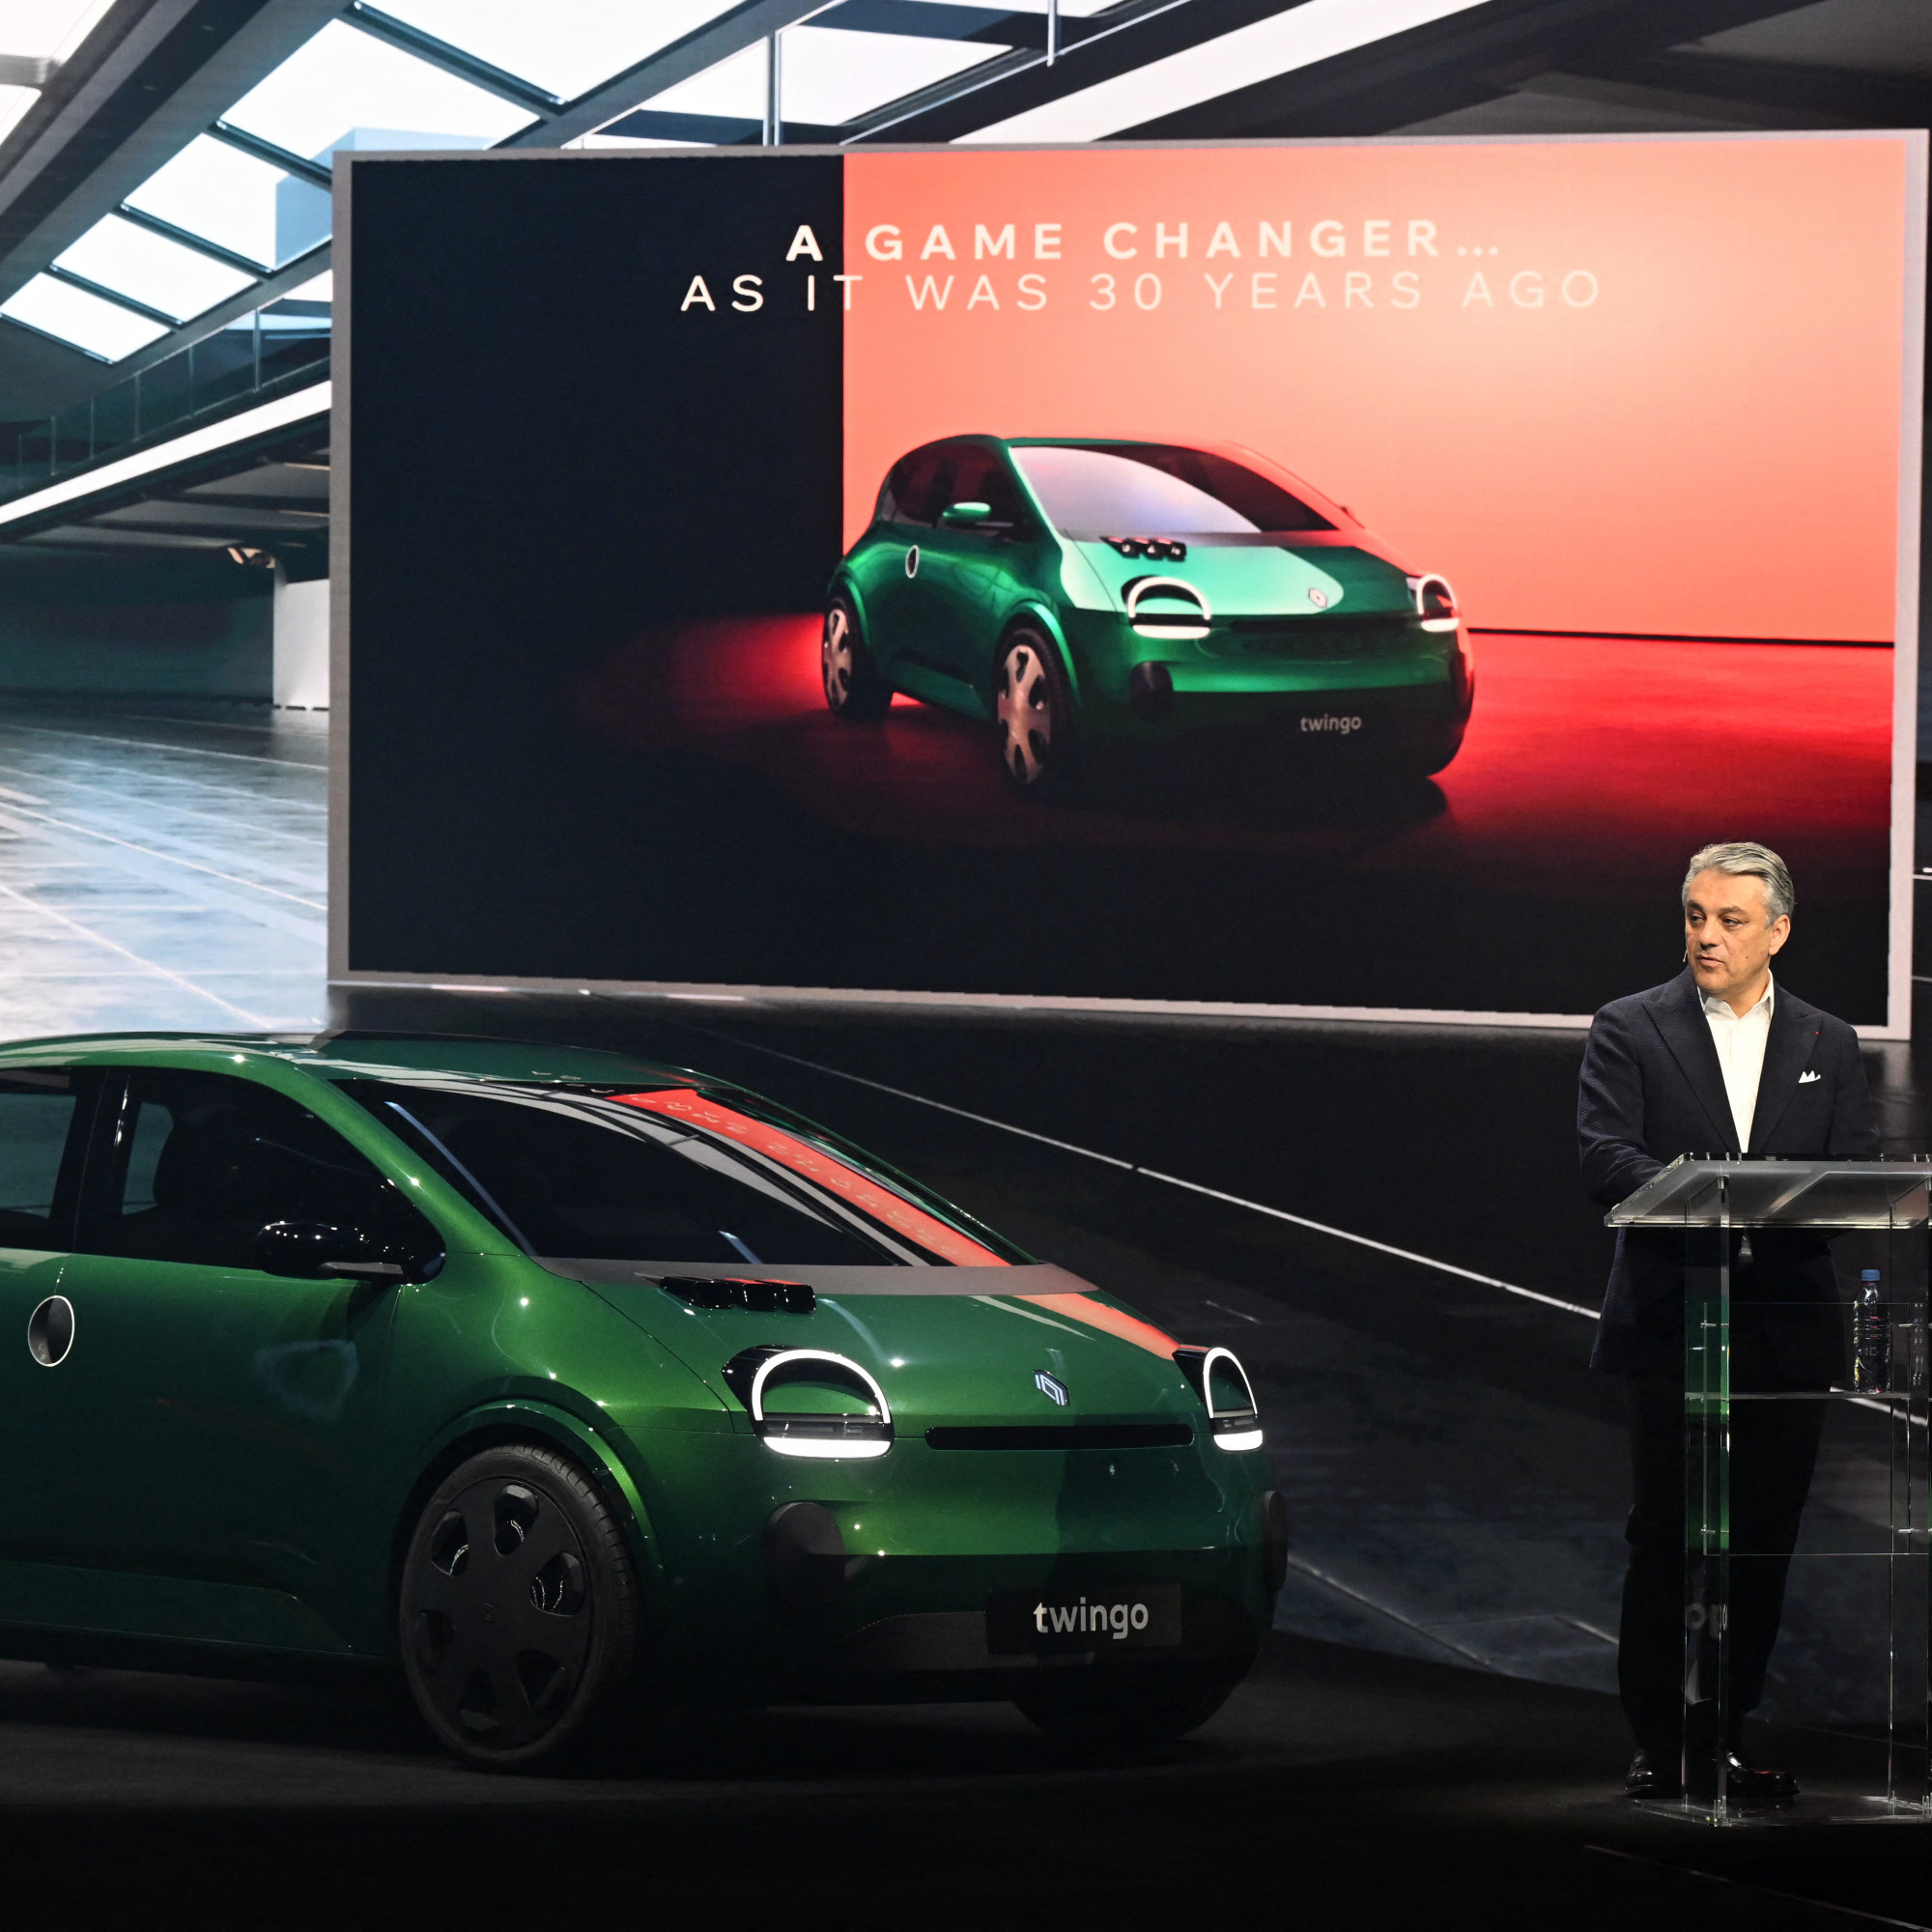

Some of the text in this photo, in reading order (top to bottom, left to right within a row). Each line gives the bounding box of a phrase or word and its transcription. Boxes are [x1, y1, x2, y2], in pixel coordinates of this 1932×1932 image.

[785, 224, 823, 261] A
[865, 222, 1063, 261] GAME
[680, 270, 1599, 312] AS IT WAS 30 YEARS AGO
[1300, 714, 1362, 734] twingo
[1033, 1597, 1149, 1639] twingo
